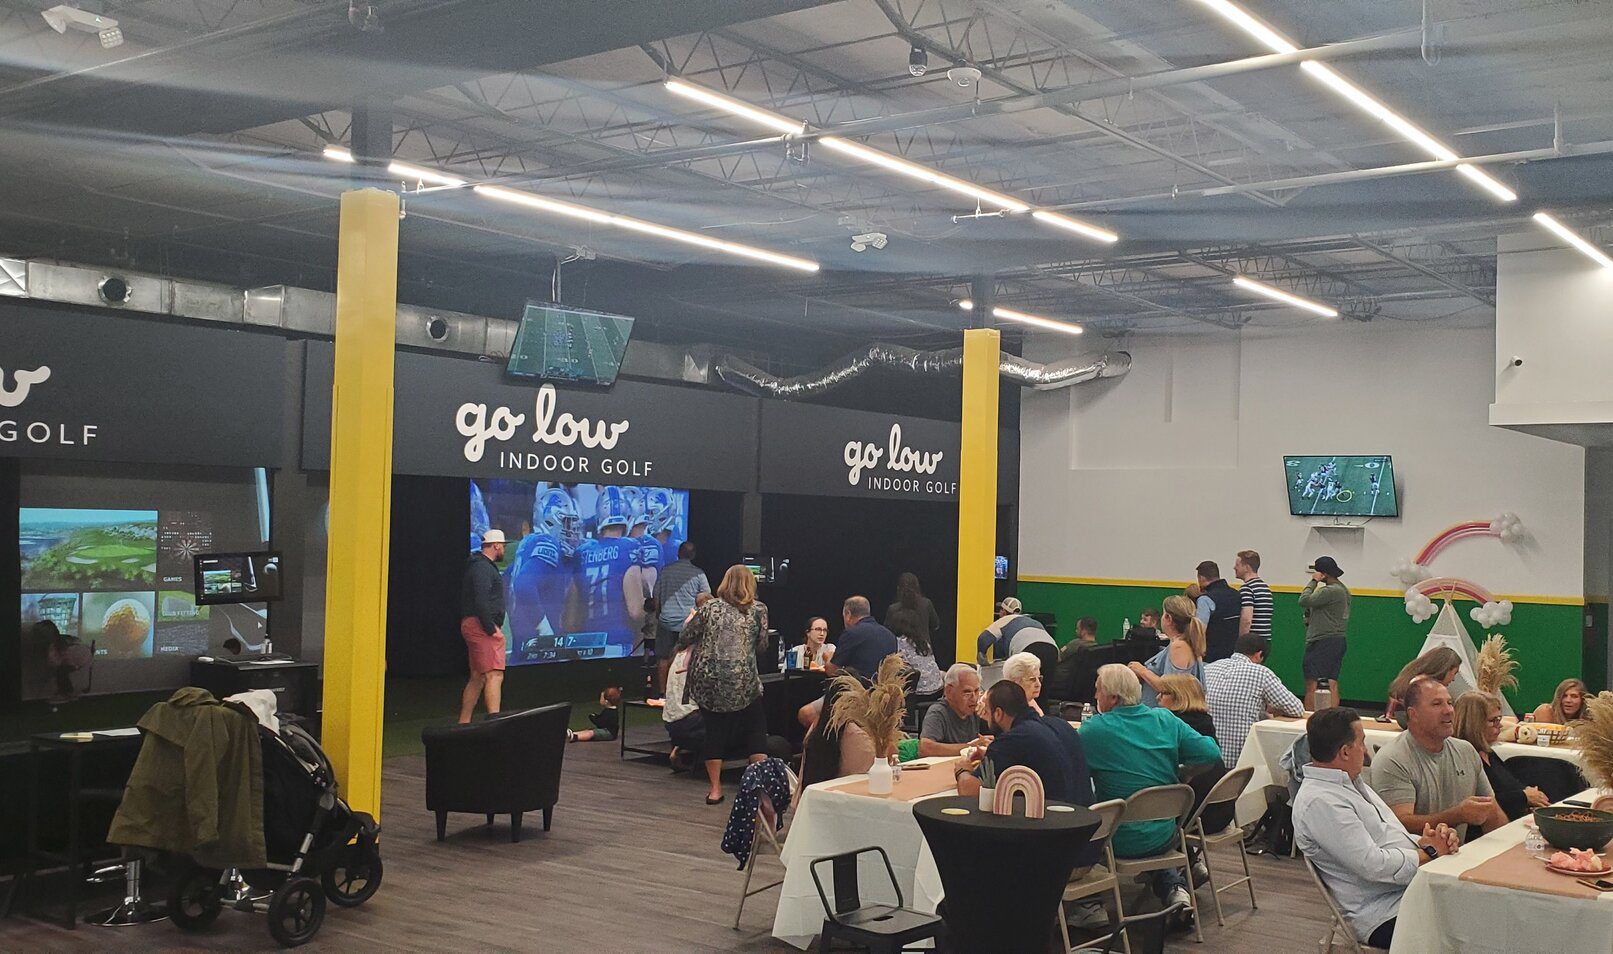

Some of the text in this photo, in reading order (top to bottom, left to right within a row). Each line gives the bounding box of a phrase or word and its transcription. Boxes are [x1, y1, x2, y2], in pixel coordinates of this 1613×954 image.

[0, 420, 98, 446] GOLF
[455, 383, 630, 463] go low
[500, 451, 653, 477] INDOOR GOLF
[844, 423, 944, 486] go low
[868, 476, 957, 495] INDOOR GOLF
[554, 636, 564, 648] 14
